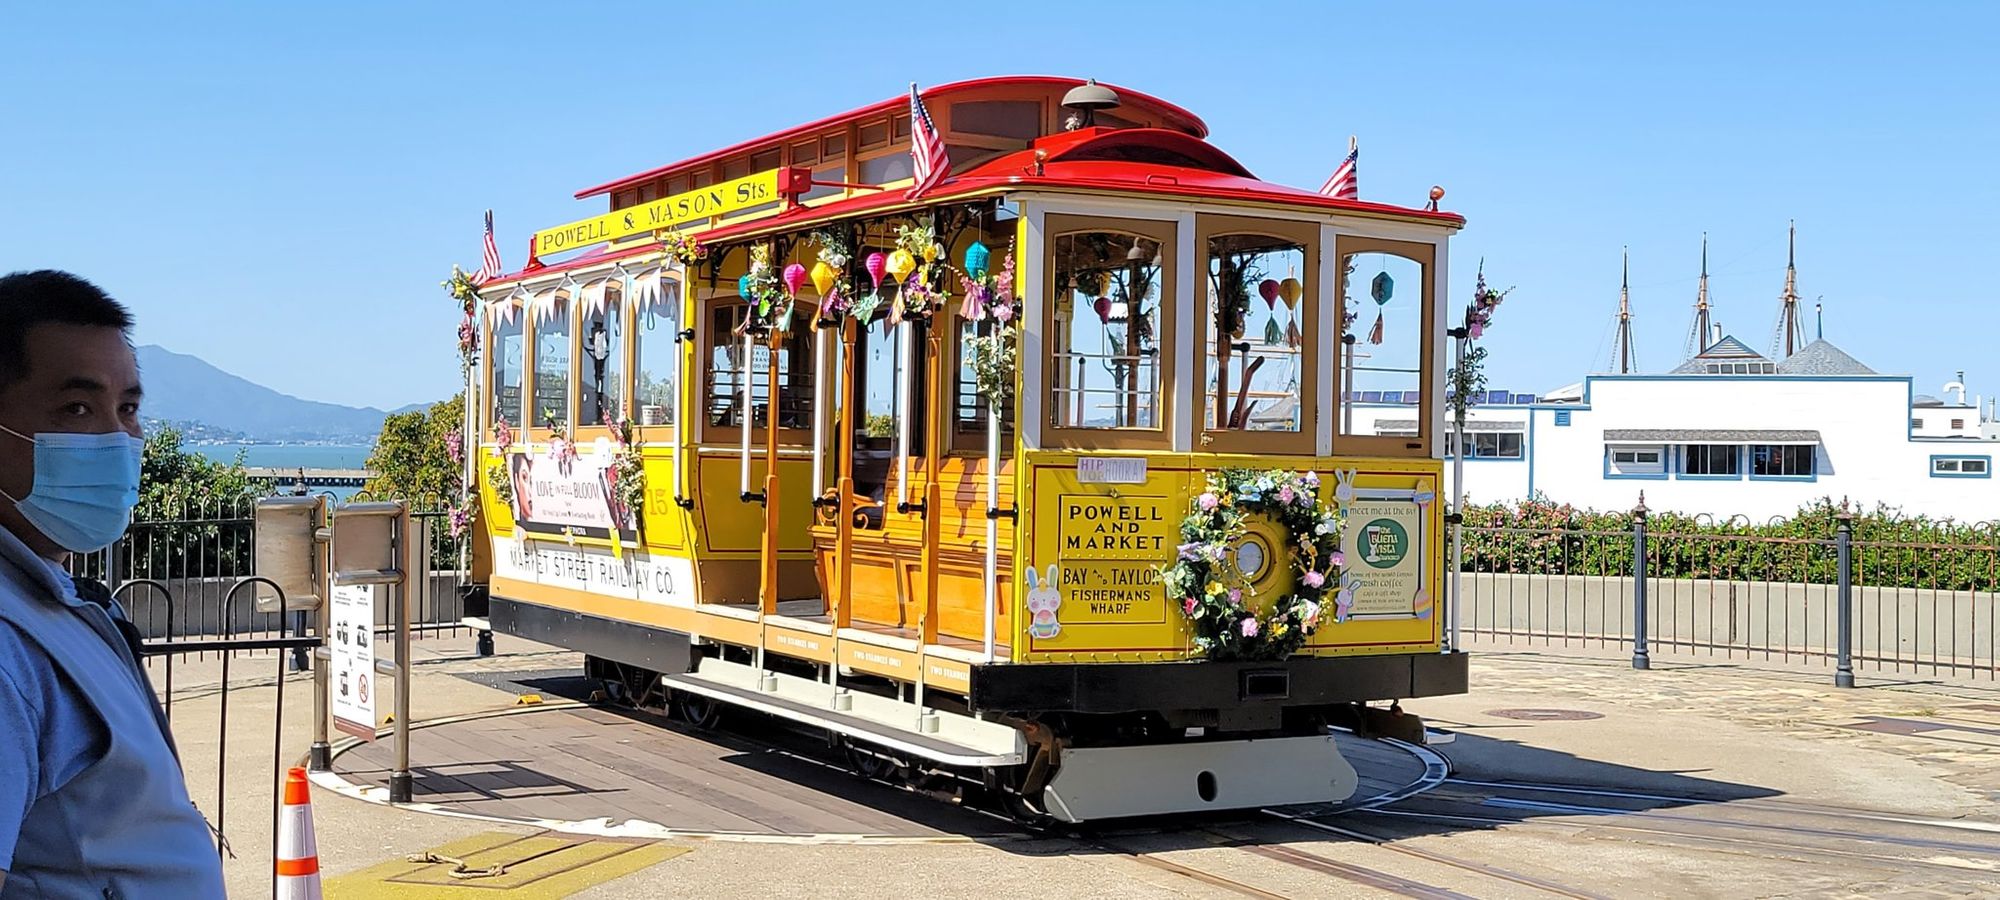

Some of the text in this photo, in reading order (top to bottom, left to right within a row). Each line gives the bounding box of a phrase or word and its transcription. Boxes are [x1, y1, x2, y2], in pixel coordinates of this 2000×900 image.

[543, 181, 769, 250] POWELL & MASON Sts.
[1081, 459, 1104, 470] HIP
[1105, 461, 1145, 480] HOORAY
[536, 480, 554, 497] LOVE
[573, 482, 600, 499] BLOOM
[647, 488, 668, 516] 15
[1070, 505, 1163, 520] POWELL
[1349, 507, 1369, 515] meet
[1383, 507, 1391, 515] at
[1393, 507, 1404, 515] the
[1094, 522, 1140, 533] AND
[1067, 535, 1164, 549] MARKET
[1371, 534, 1398, 544] BUENA
[1376, 544, 1396, 554] VISTA
[554, 555, 594, 583] STREET
[600, 562, 650, 591] RAILWAY
[1063, 568, 1160, 585] BAY AND TAYLOR
[1071, 589, 1151, 601] FISHERMANS
[1090, 603, 1131, 614] WHARF
